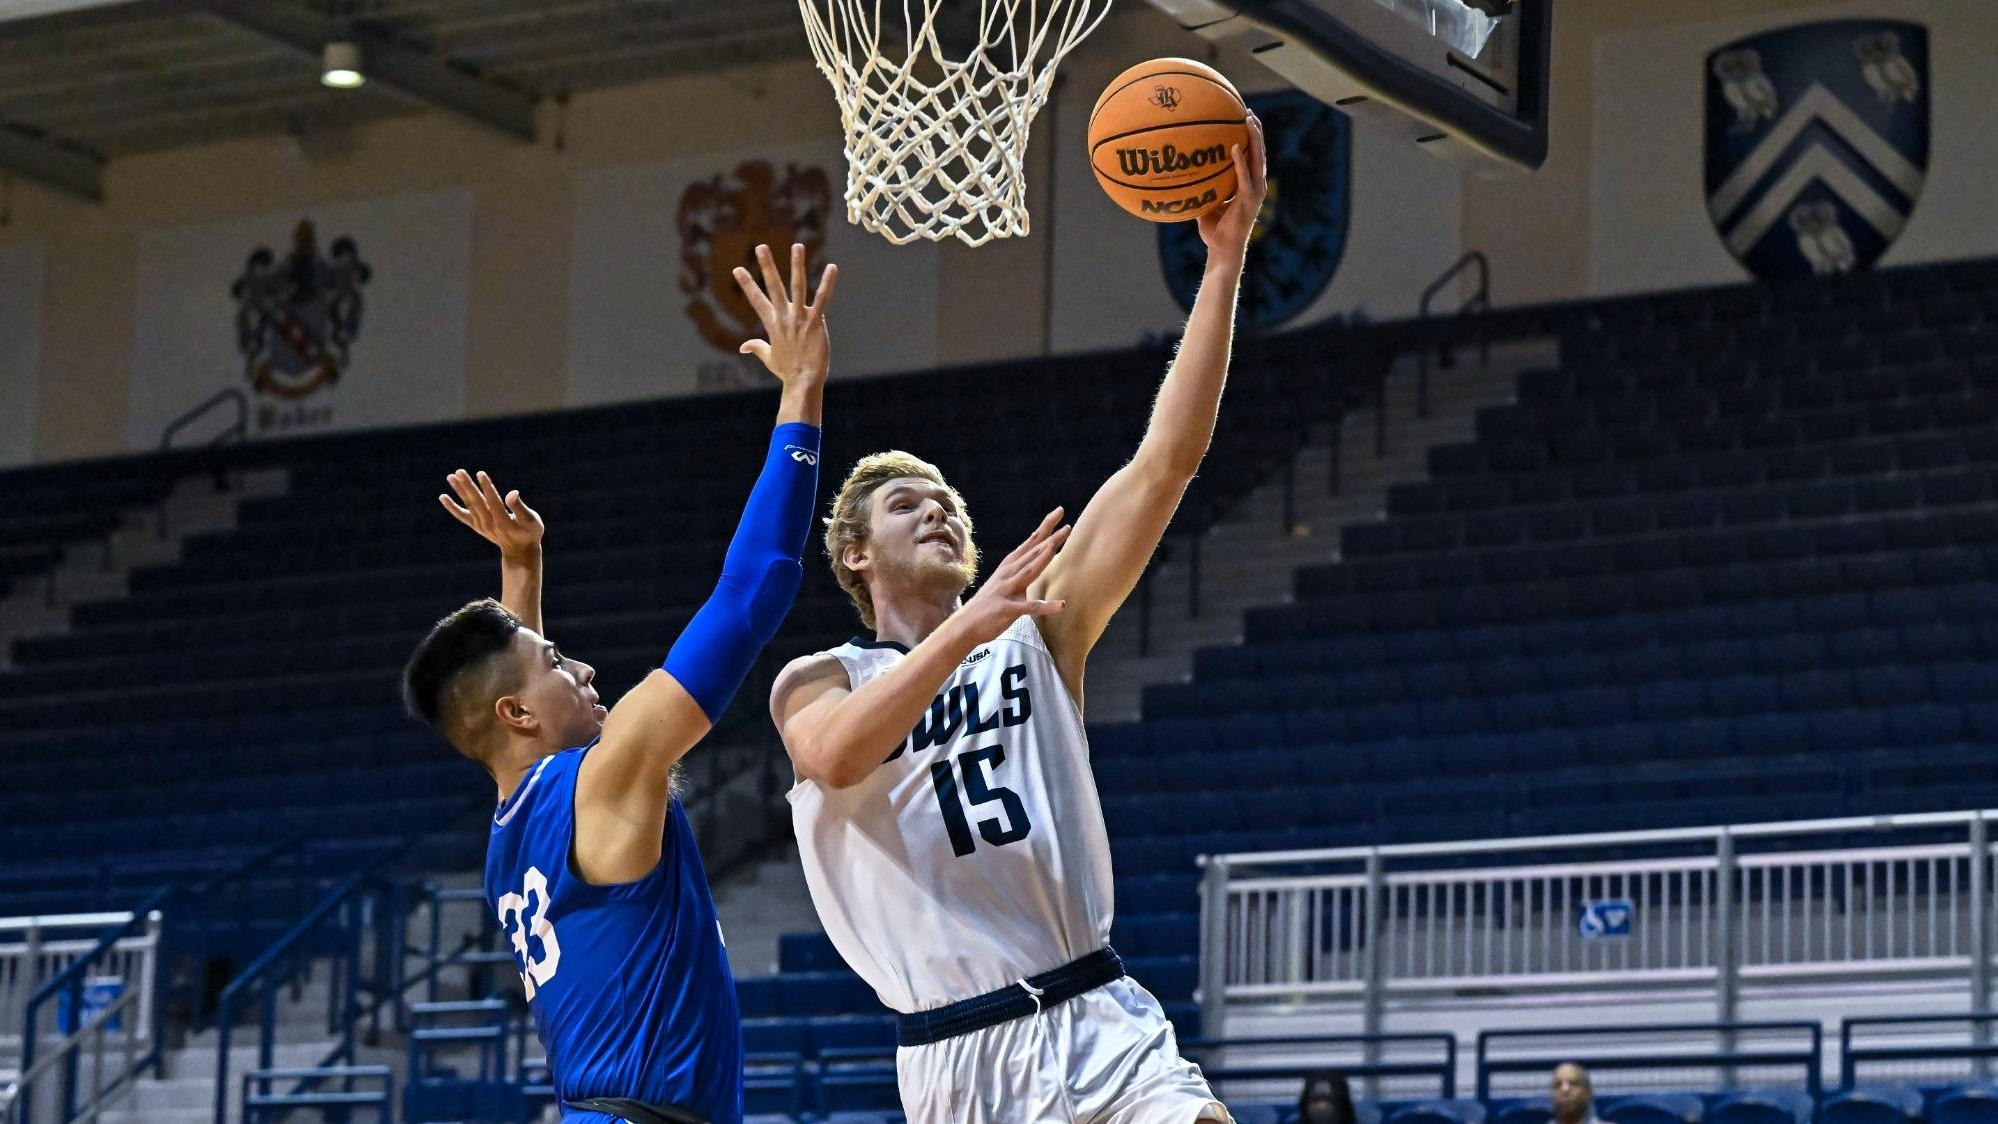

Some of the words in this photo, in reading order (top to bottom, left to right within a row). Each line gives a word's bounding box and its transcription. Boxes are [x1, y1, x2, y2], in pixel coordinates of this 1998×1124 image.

[1116, 143, 1226, 177] Wilson
[1141, 188, 1218, 214] NCAA
[930, 743, 1032, 858] 15
[498, 866, 562, 1003] 33
